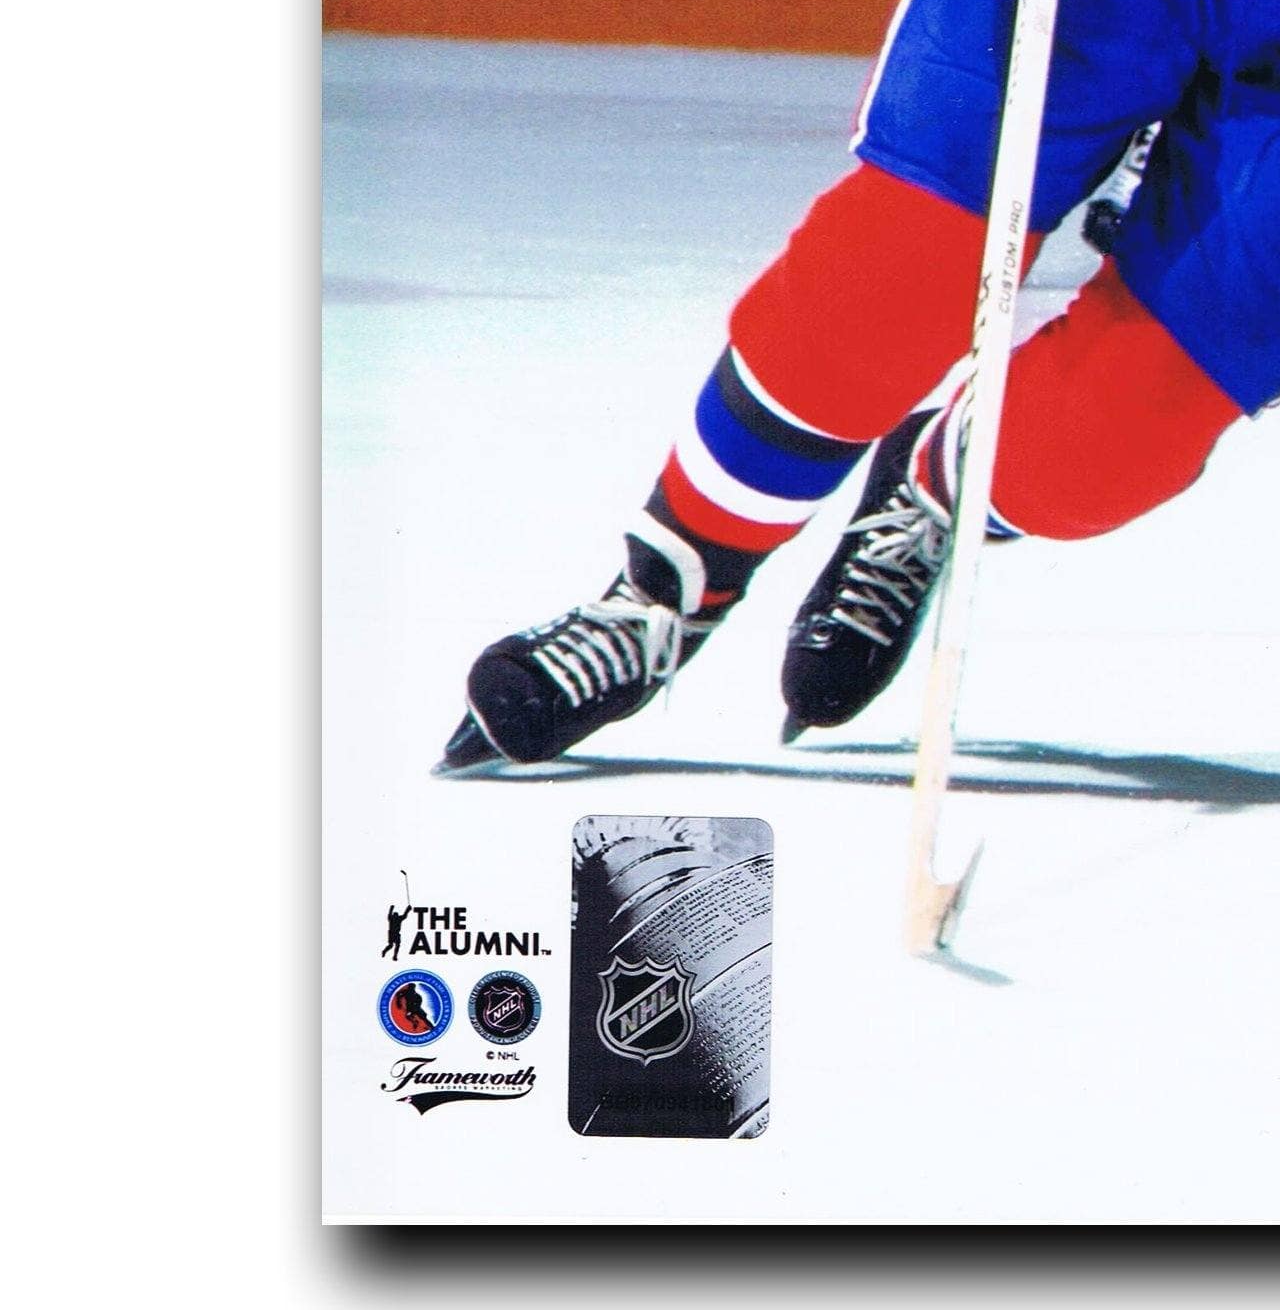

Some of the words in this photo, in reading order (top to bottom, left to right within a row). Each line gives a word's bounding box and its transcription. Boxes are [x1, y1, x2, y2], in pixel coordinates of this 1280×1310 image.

[1008, 199, 1025, 233] PRO
[998, 243, 1019, 315] CUSTOM
[618, 980, 677, 1039] NHL
